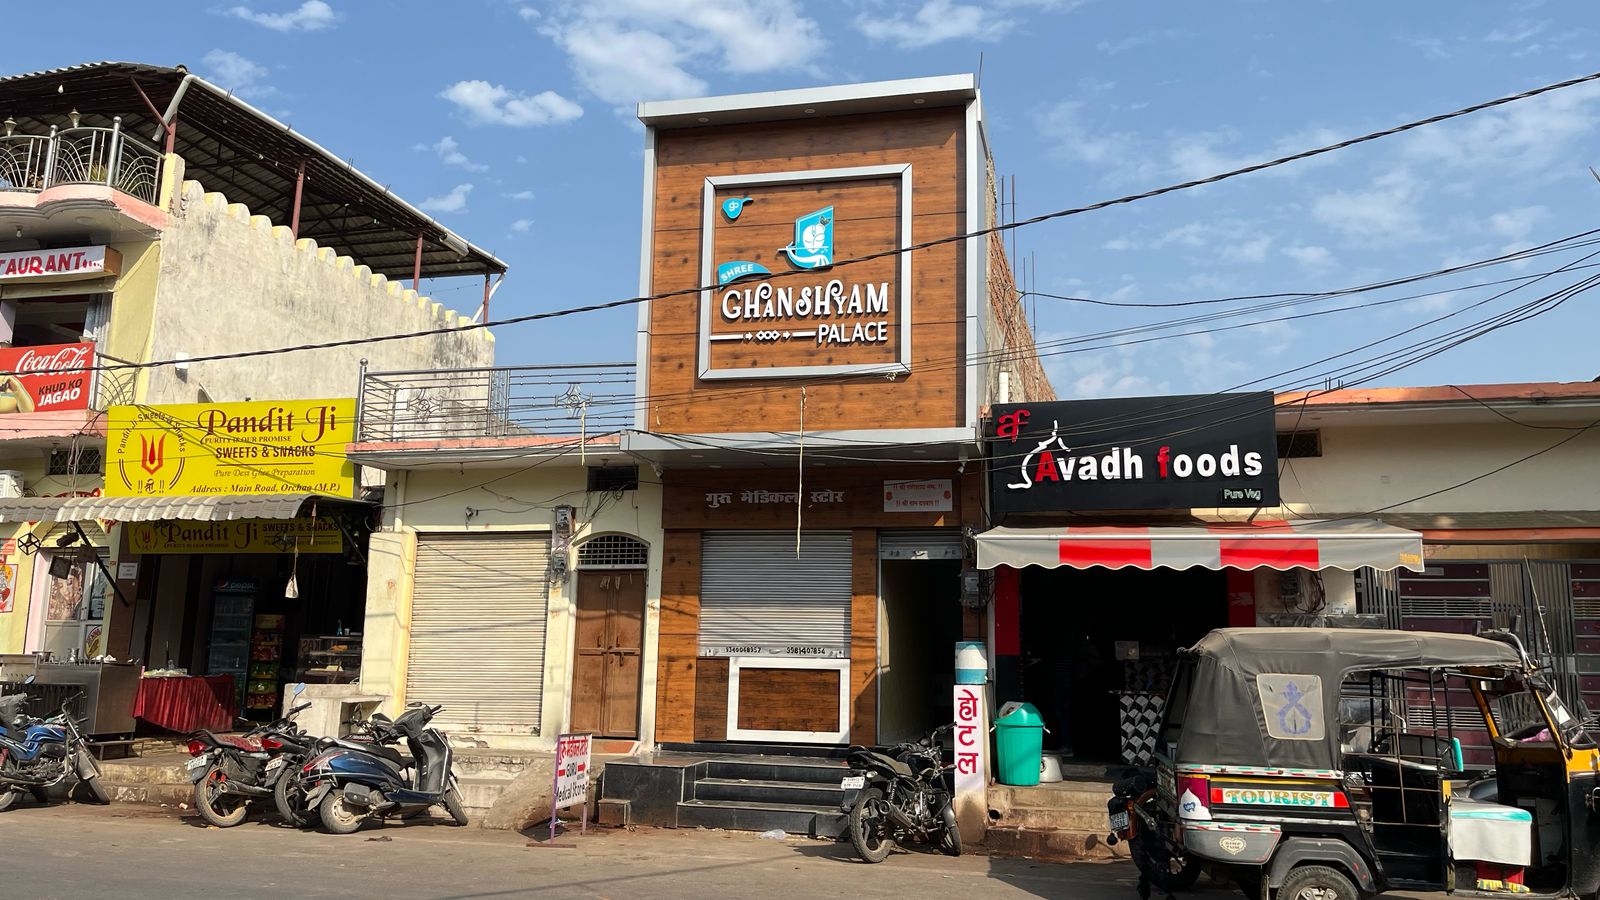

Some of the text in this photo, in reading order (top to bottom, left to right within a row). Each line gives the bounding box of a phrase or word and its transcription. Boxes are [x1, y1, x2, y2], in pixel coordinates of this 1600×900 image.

[720, 264, 754, 282] SHREE
[722, 280, 889, 319] GHANSHYAM
[818, 322, 888, 343] PALACE
[16, 346, 91, 377] Coca-Cola
[39, 379, 82, 396] KHUD KO
[38, 388, 80, 406] JAGAO
[118, 428, 131, 454] Pandit
[138, 411, 165, 422] Sweets
[198, 406, 336, 444] Pandit Ji
[216, 446, 316, 459] SWEETS & SNACKS
[1035, 445, 1263, 481] Avadh foods
[233, 469, 249, 477] Desi
[252, 468, 269, 477] Ghee
[272, 468, 315, 478] Preparation
[190, 485, 221, 493] Address
[231, 484, 253, 492] Main
[255, 482, 278, 493] Road,
[314, 482, 341, 494] (M.P.)
[810, 489, 844, 503] स्टोर
[1224, 488, 1262, 502] Pure Veg
[160, 520, 258, 549] Pandit Ji
[262, 522, 295, 531] SWEETS
[957, 688, 979, 775] होटल
[1225, 790, 1331, 807] TOURIST
